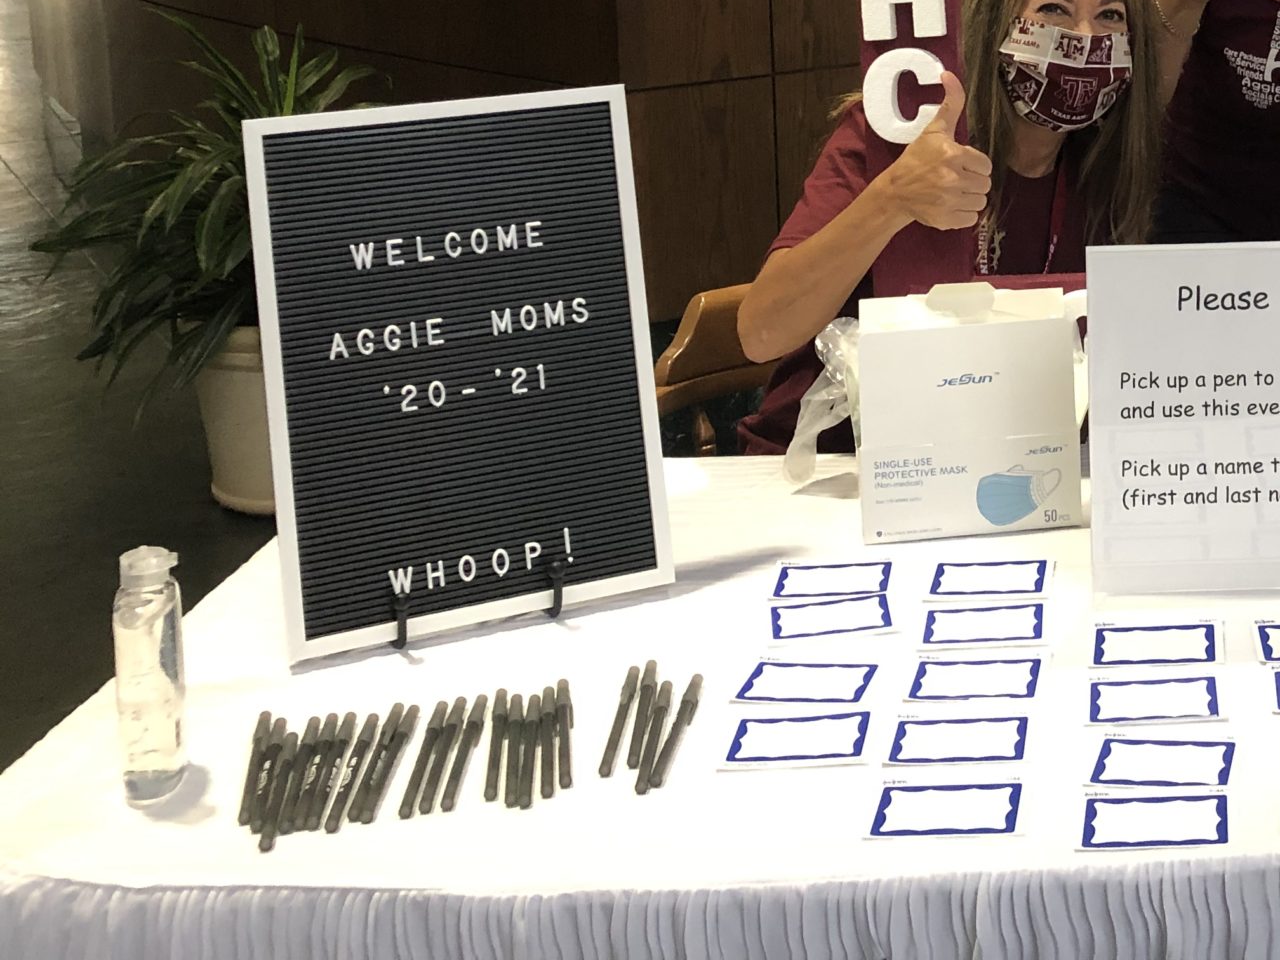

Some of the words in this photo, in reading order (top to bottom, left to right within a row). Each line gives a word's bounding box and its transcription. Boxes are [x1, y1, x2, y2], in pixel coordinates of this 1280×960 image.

[1235, 57, 1266, 72] Service
[1050, 107, 1071, 120] TEXAS
[350, 220, 544, 271] WELCOME
[1177, 284, 1270, 312] Please
[329, 317, 445, 361] AGGIE
[490, 297, 590, 337] MOMS
[1120, 370, 1160, 390] Pick
[1166, 375, 1189, 394] up
[1195, 375, 1207, 388] a
[1213, 373, 1247, 393] pen
[1253, 370, 1274, 386] to
[1120, 400, 1155, 420] and
[1162, 404, 1195, 418] use
[1201, 398, 1240, 417] this
[873, 456, 933, 471] SINGLE-USE
[874, 468, 937, 481] PROTECTIVE
[939, 465, 968, 476] MASK
[1121, 458, 1162, 478] Pick
[1167, 463, 1190, 481] up
[1196, 462, 1208, 475] a
[1214, 460, 1265, 475] name
[874, 479, 924, 490] (Non-medical)
[1122, 488, 1177, 511] (first
[1183, 486, 1218, 505] and
[1225, 485, 1262, 504] last
[1044, 508, 1058, 523] 50
[388, 527, 575, 596] WHOOP!
